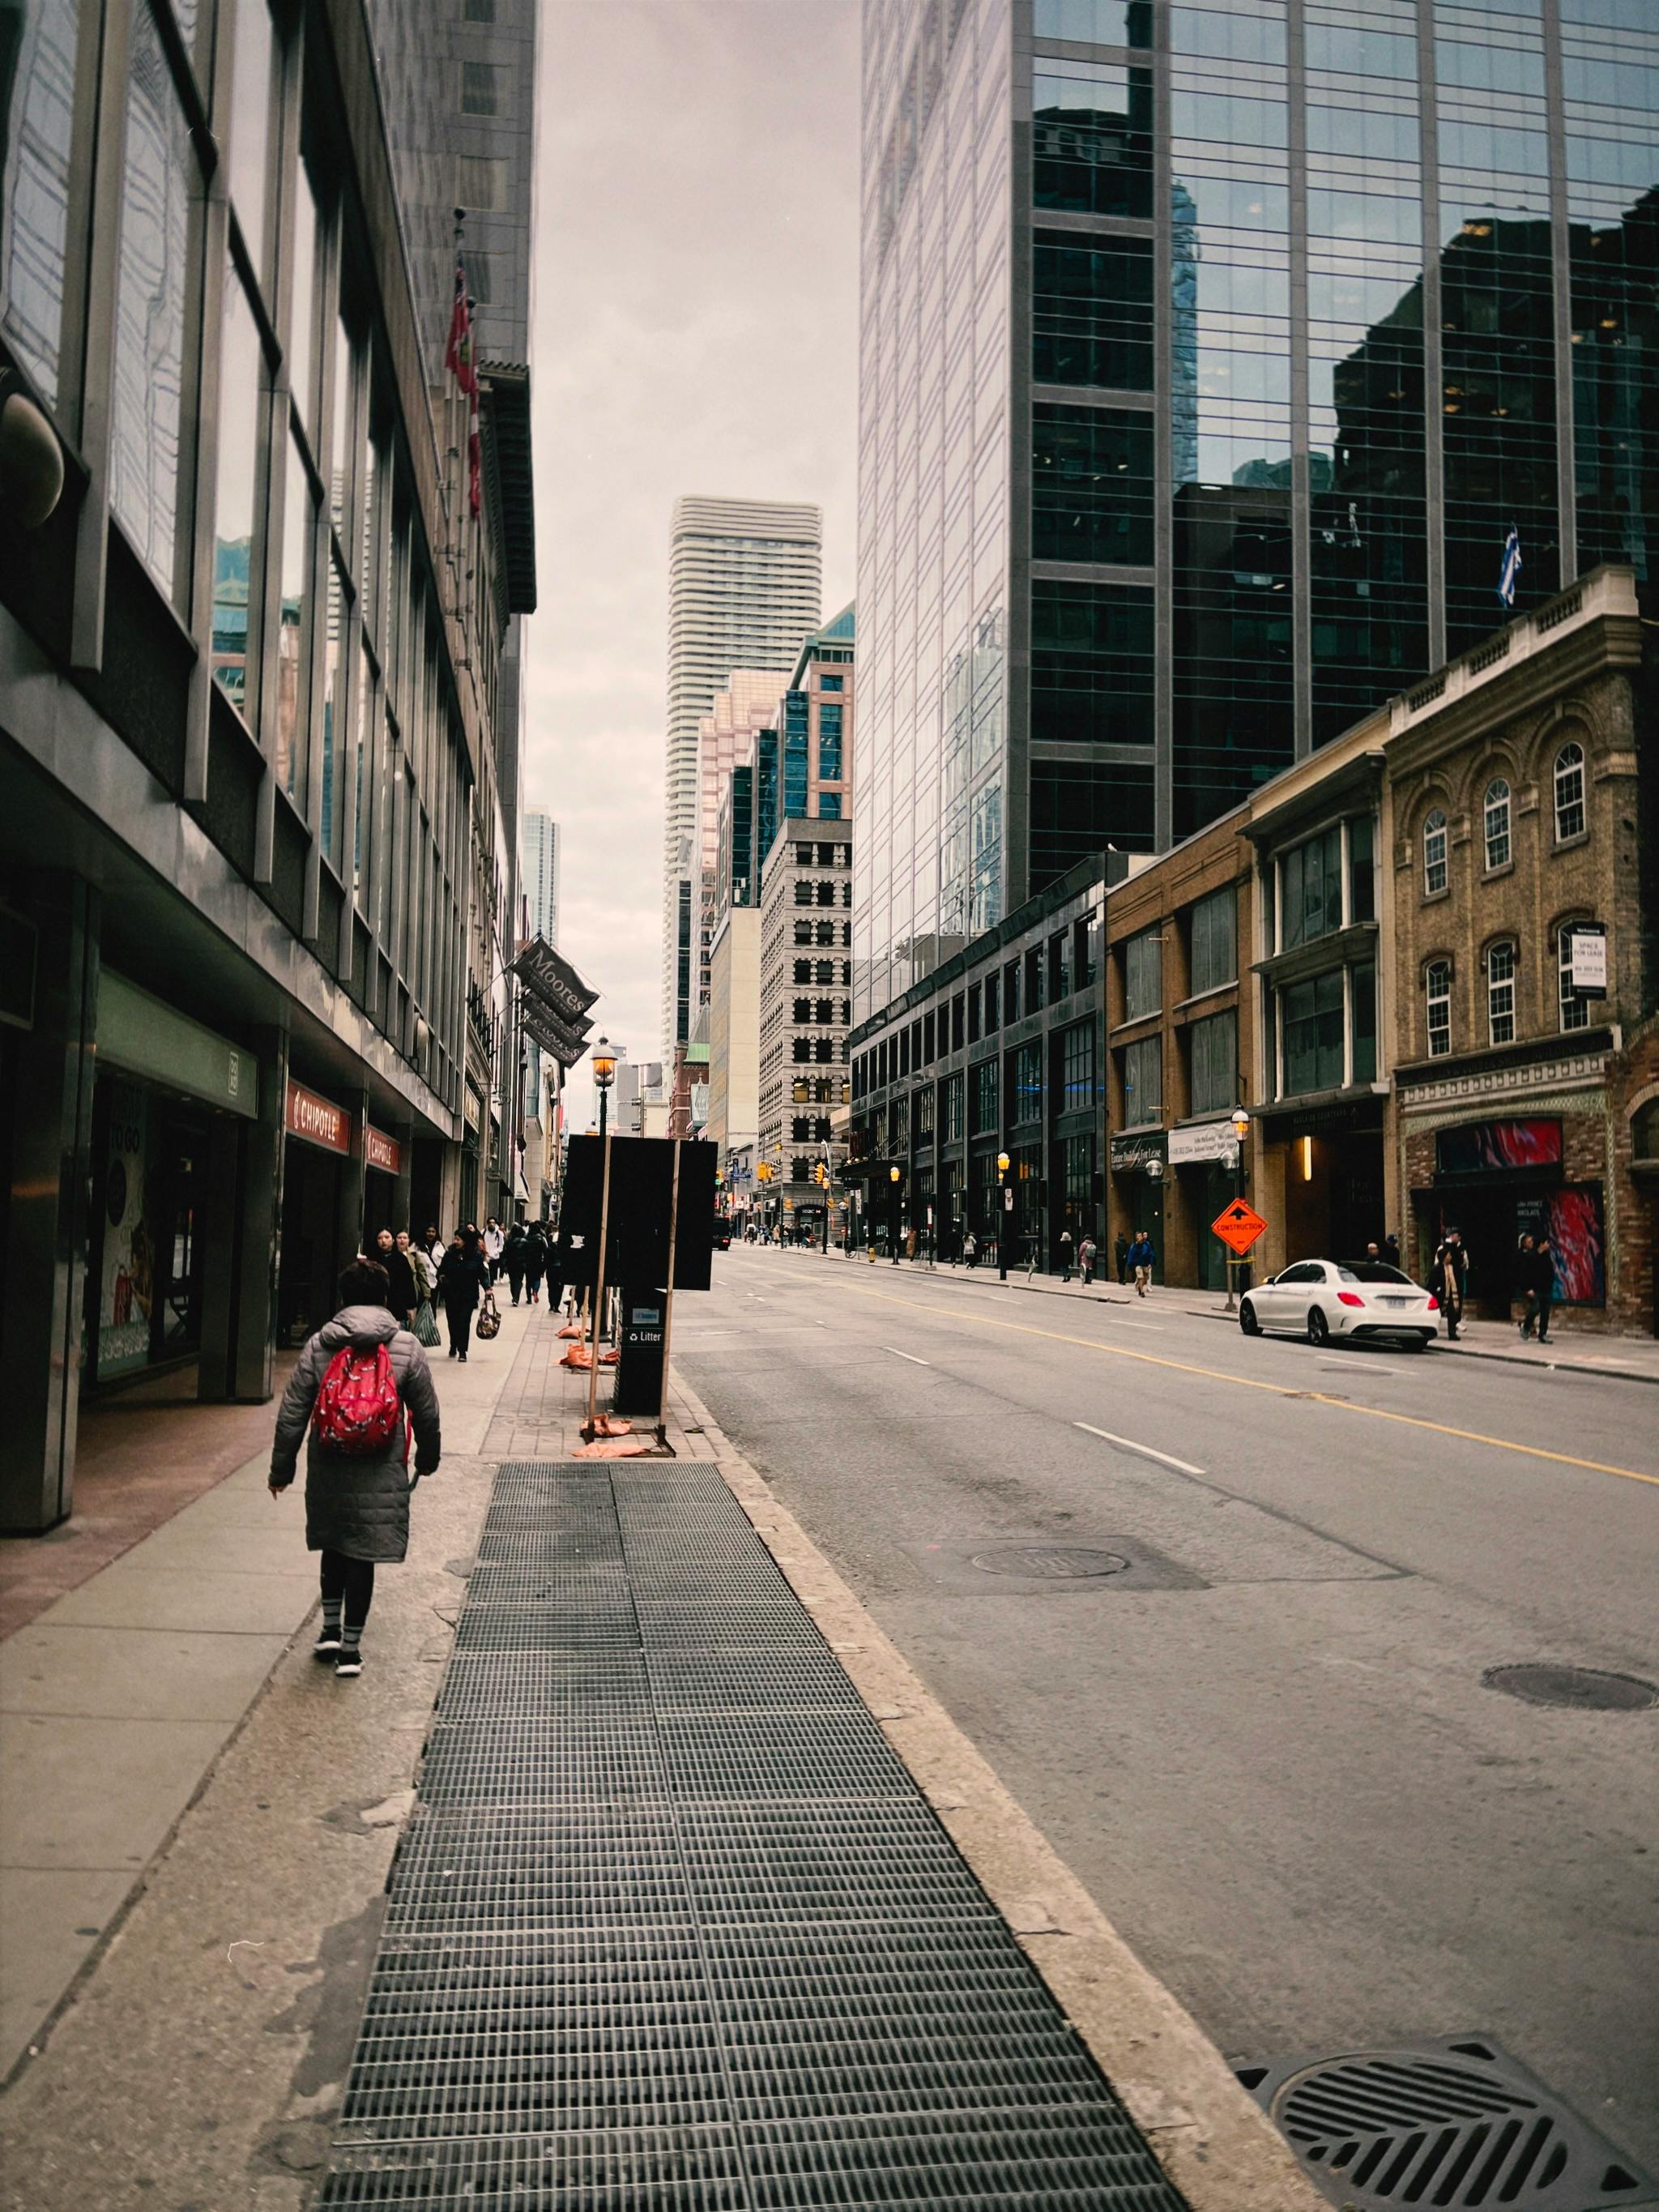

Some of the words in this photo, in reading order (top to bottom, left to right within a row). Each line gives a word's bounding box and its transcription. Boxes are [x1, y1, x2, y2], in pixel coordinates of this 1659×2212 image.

[529, 948, 584, 1012] Moores
[301, 1098, 337, 1142] CHIPOTLE
[371, 1137, 392, 1165] CHIPOTLE
[1149, 1147, 1162, 1159] Lease
[1217, 1223, 1263, 1232] CONSTRUCTION
[640, 1331, 662, 1342] Litter
